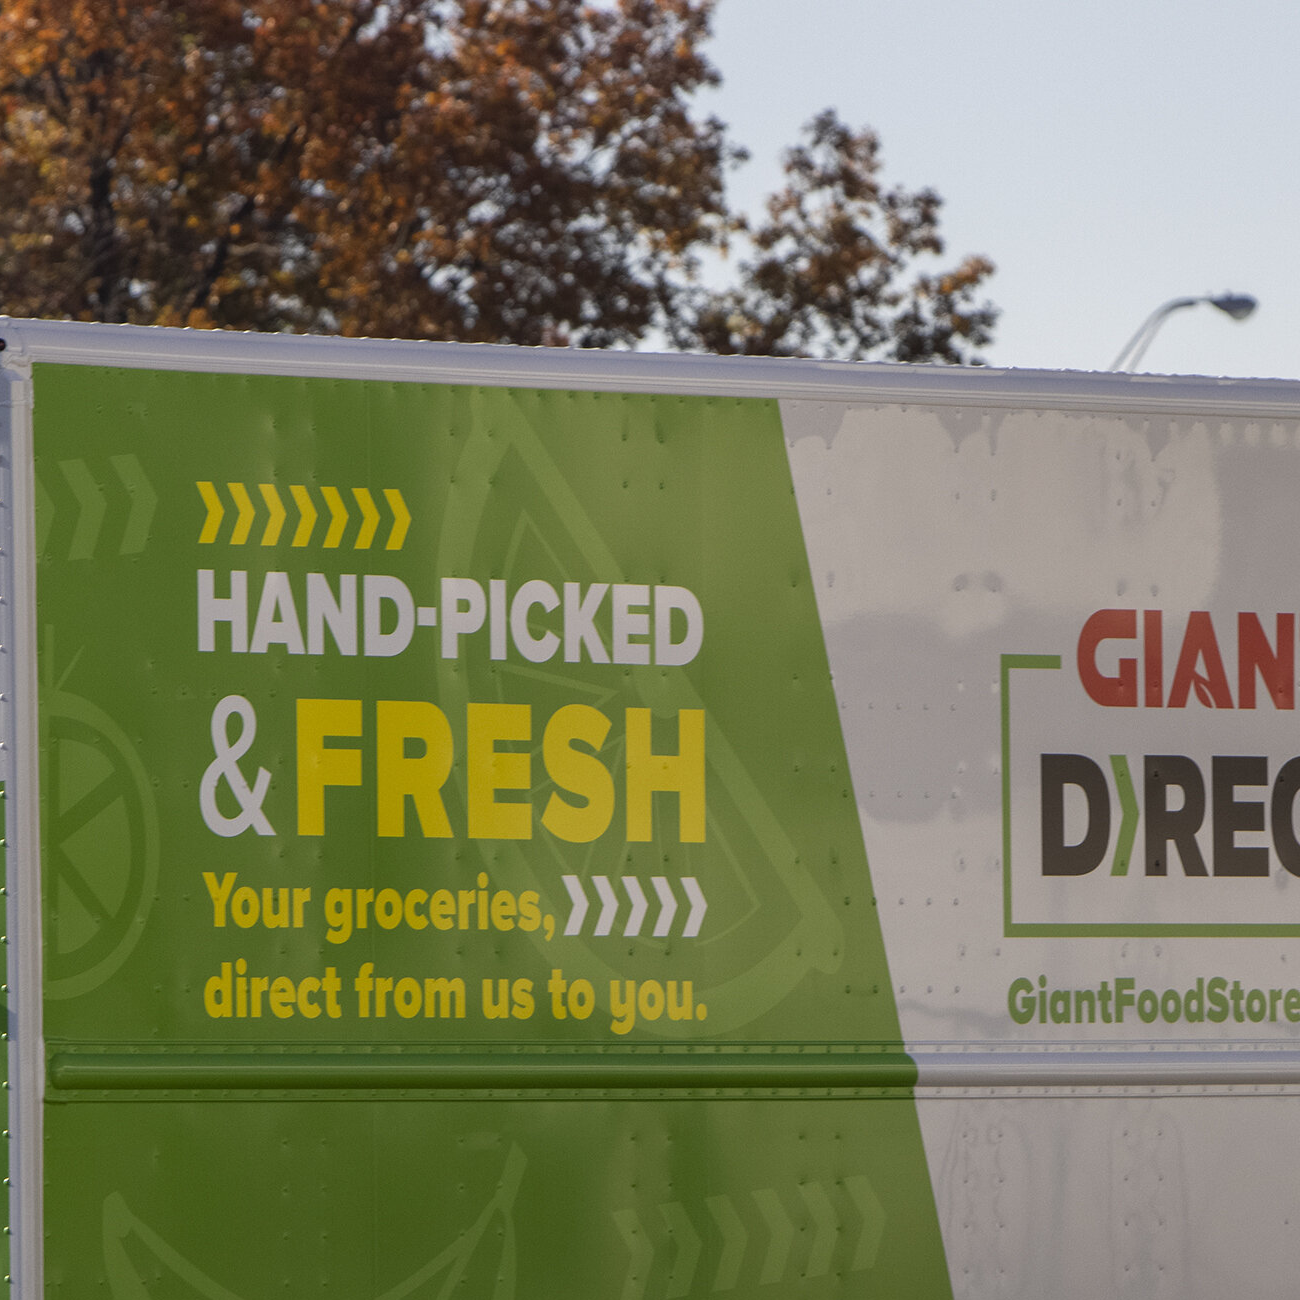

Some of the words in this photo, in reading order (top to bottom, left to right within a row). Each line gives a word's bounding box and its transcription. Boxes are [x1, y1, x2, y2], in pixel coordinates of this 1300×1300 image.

[196, 568, 705, 667] HAND-PICKED
[199, 694, 278, 838] &
[296, 697, 707, 843] FRESH
[202, 871, 312, 929] Your
[324, 871, 556, 945] groceries,
[203, 958, 342, 1020] direct
[354, 962, 466, 1019] from
[482, 975, 536, 1021] us
[547, 968, 595, 1022] to
[609, 978, 708, 1036] you.
